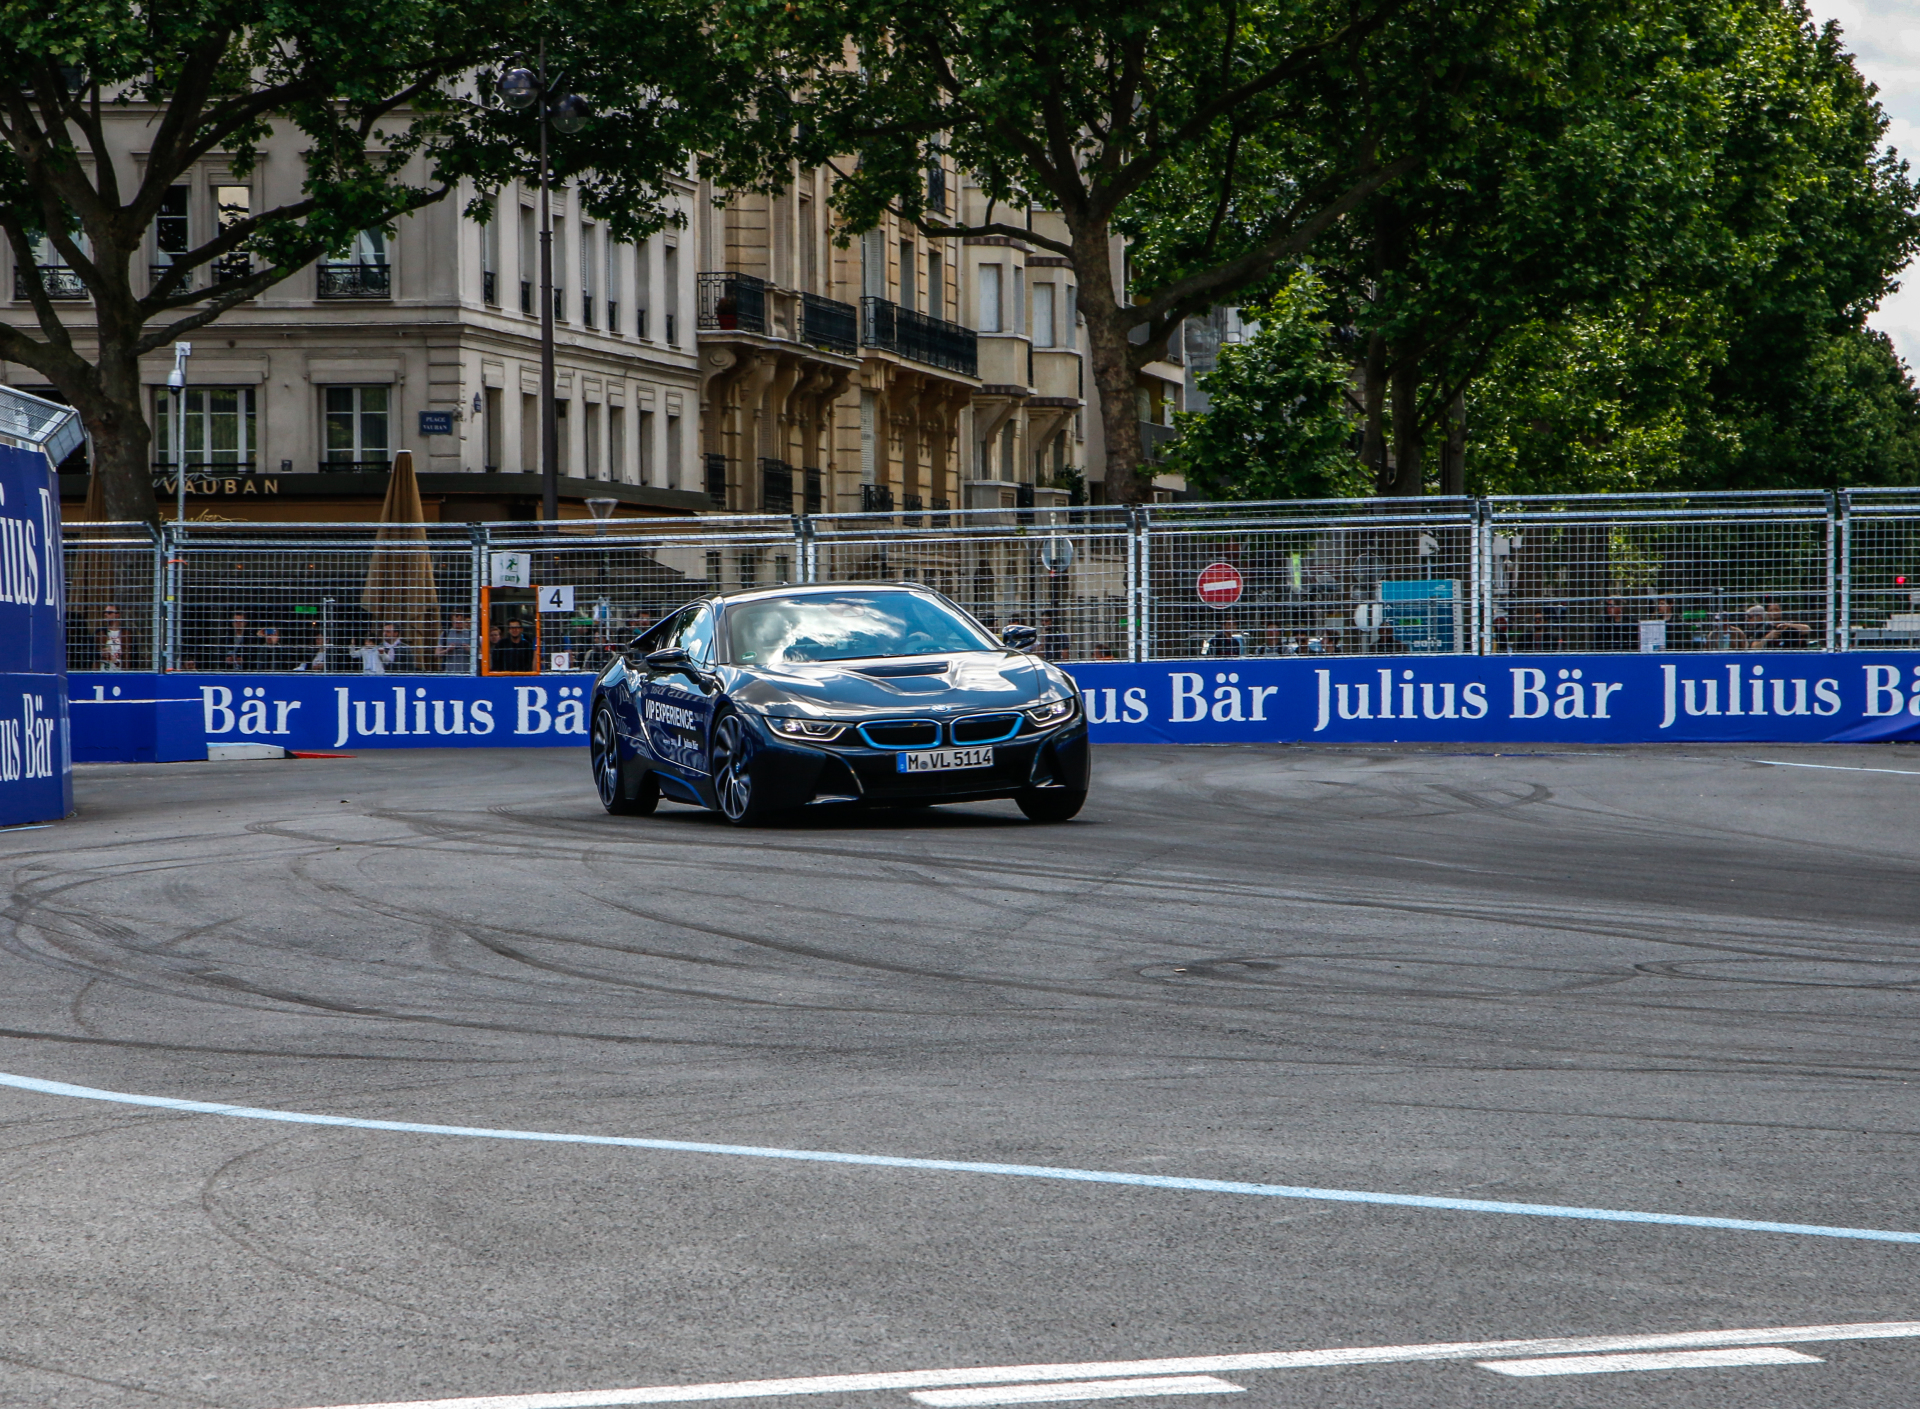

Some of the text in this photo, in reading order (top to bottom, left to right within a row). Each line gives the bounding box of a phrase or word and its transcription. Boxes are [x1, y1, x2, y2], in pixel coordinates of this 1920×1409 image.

[164, 480, 279, 494] VAUBAN
[0, 483, 38, 605] ius
[549, 589, 563, 608] 4
[201, 686, 588, 747] Bär Julius Bä
[1082, 687, 1148, 724] us
[1168, 673, 1278, 722] Bär
[1314, 669, 1488, 732] Julius
[1509, 668, 1623, 719] Bär
[1659, 664, 1841, 729] Julius
[0, 693, 54, 781] us Bär
[954, 748, 991, 767] 5114
